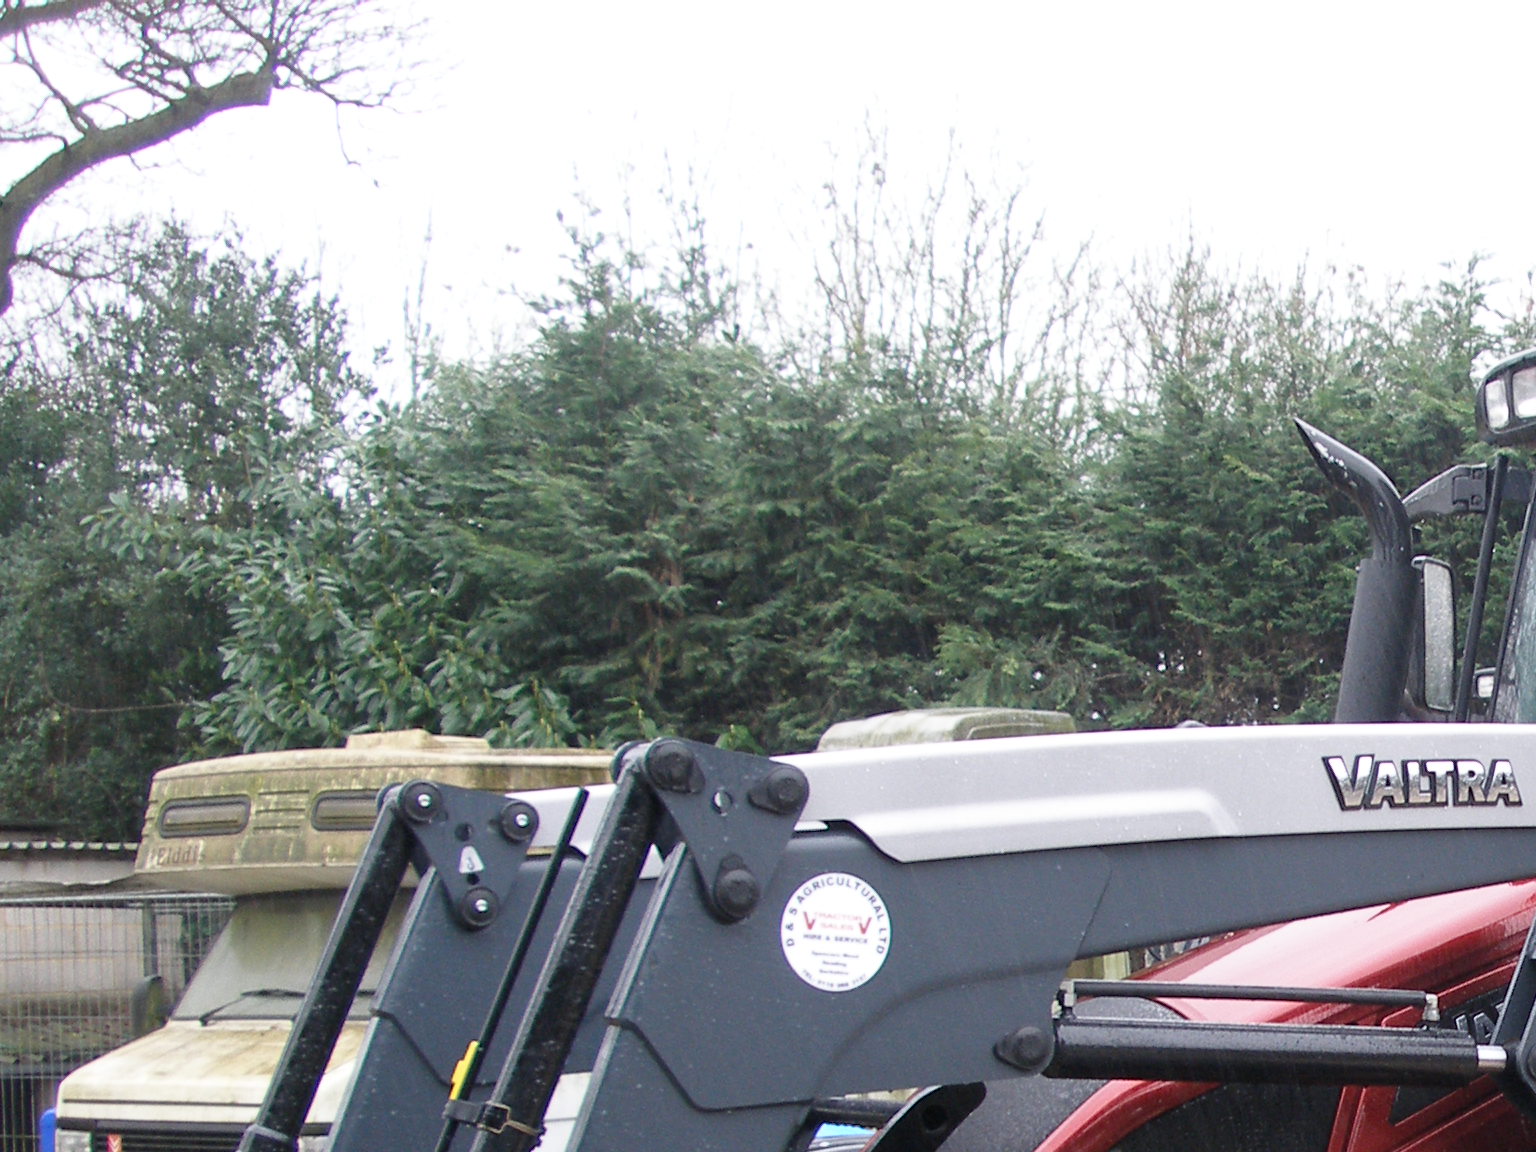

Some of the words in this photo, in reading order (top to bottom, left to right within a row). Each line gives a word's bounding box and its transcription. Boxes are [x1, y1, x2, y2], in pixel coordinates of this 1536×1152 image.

[1321, 753, 1523, 811] VALTRA
[797, 877, 885, 922] AGRICULTURAL
[789, 907, 798, 916] S
[785, 922, 794, 931] &
[786, 938, 795, 947] D
[876, 927, 887, 954] LTD
